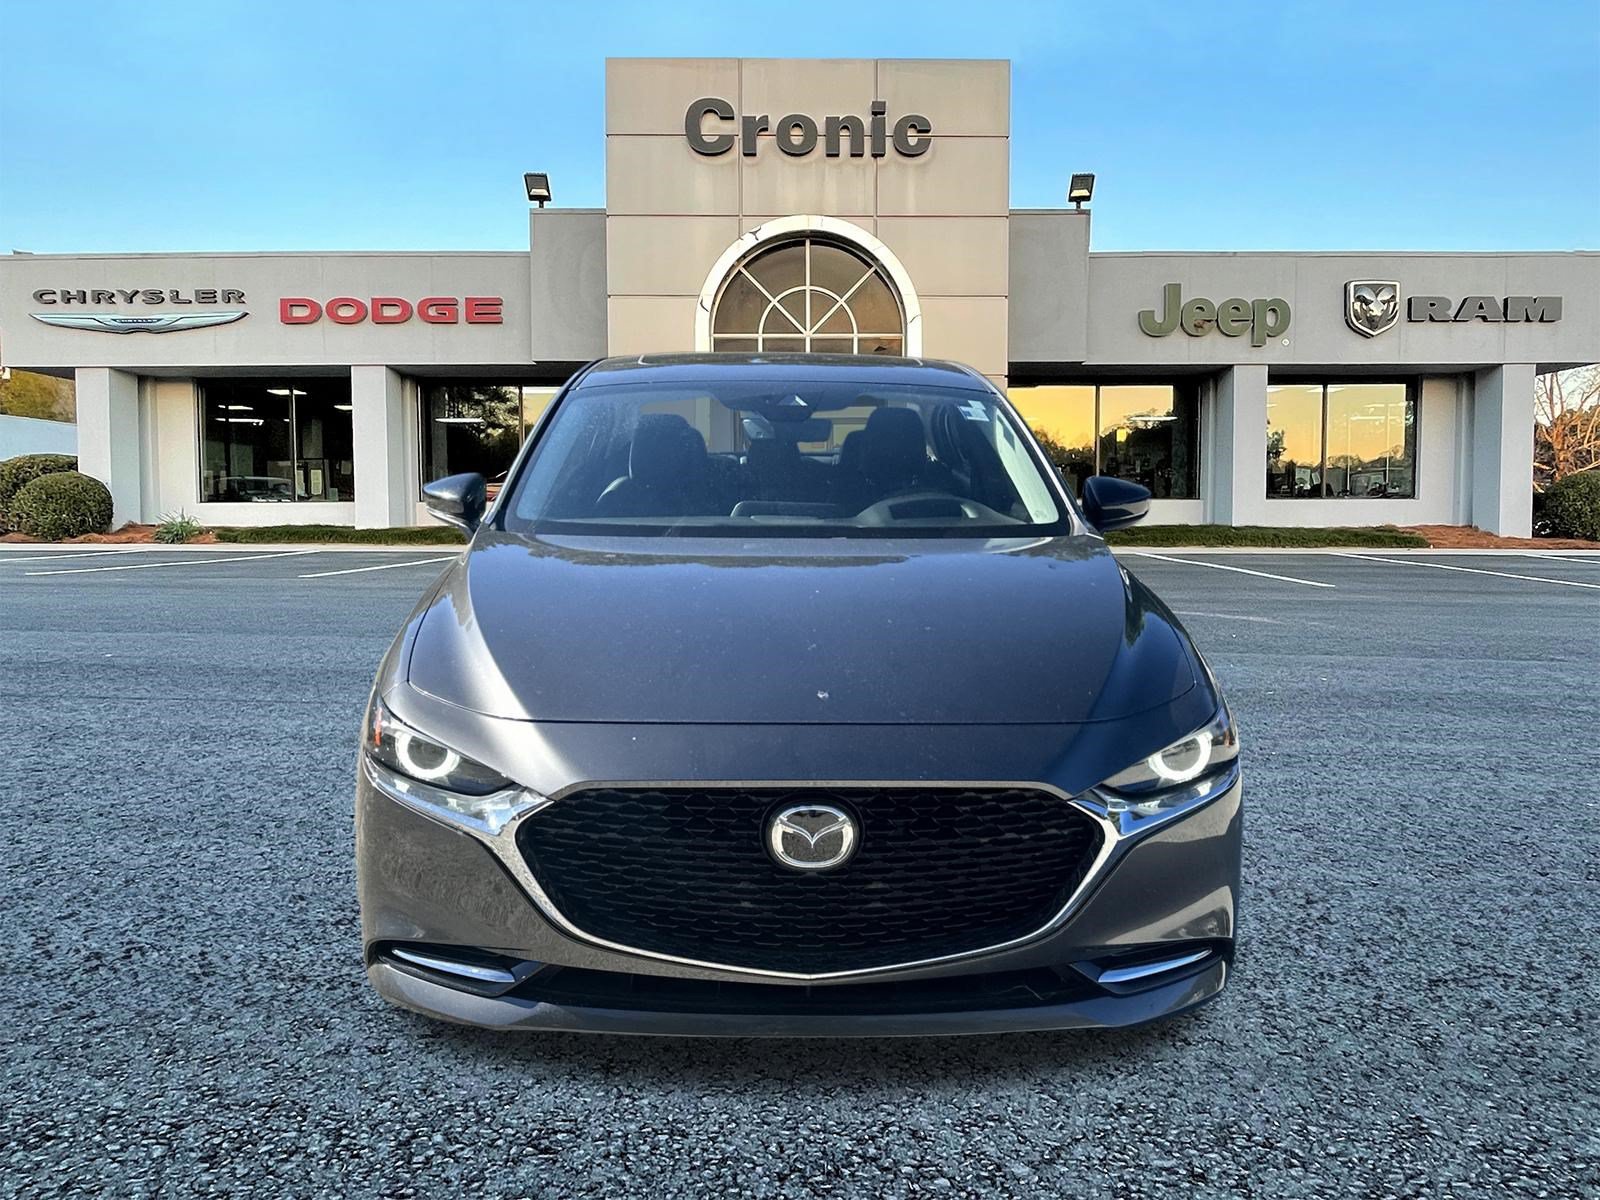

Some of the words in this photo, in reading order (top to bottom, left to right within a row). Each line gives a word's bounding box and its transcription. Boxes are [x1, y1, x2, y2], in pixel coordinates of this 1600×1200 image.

[685, 97, 932, 157] Cronic
[32, 288, 247, 304] CHRYSLER
[1407, 296, 1563, 322] RAM
[280, 297, 503, 324] DODGE
[1138, 283, 1291, 346] Jeep
